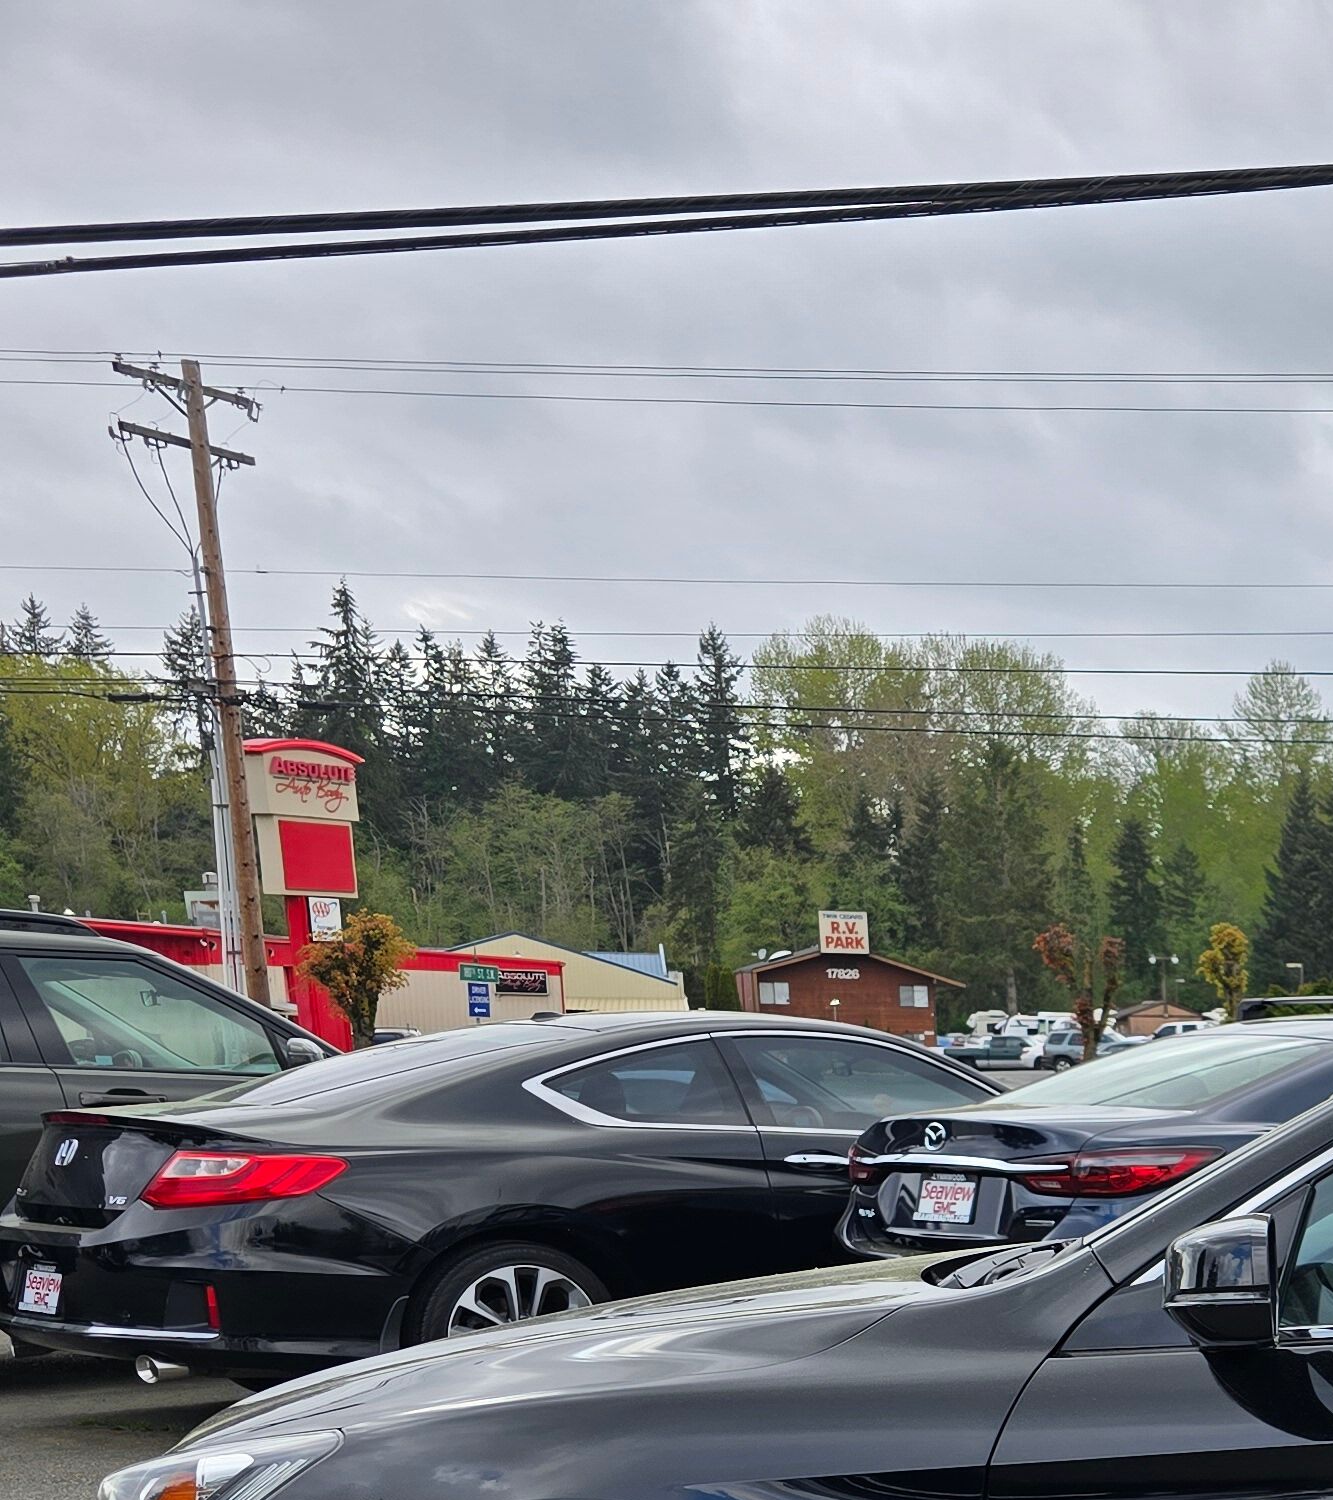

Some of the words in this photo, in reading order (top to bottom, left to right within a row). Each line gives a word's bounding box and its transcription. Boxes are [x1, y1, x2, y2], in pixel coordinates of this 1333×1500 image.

[269, 756, 356, 782] ABSOLUTE
[275, 777, 312, 803] Auto
[316, 778, 349, 813] Body
[831, 921, 858, 934] R.V.
[825, 936, 864, 949] PARK
[826, 968, 860, 979] 17826
[921, 1182, 975, 1201] Seaview
[108, 1195, 127, 1205] V6
[933, 1201, 957, 1214] GMC
[26, 1271, 61, 1293] Seaview
